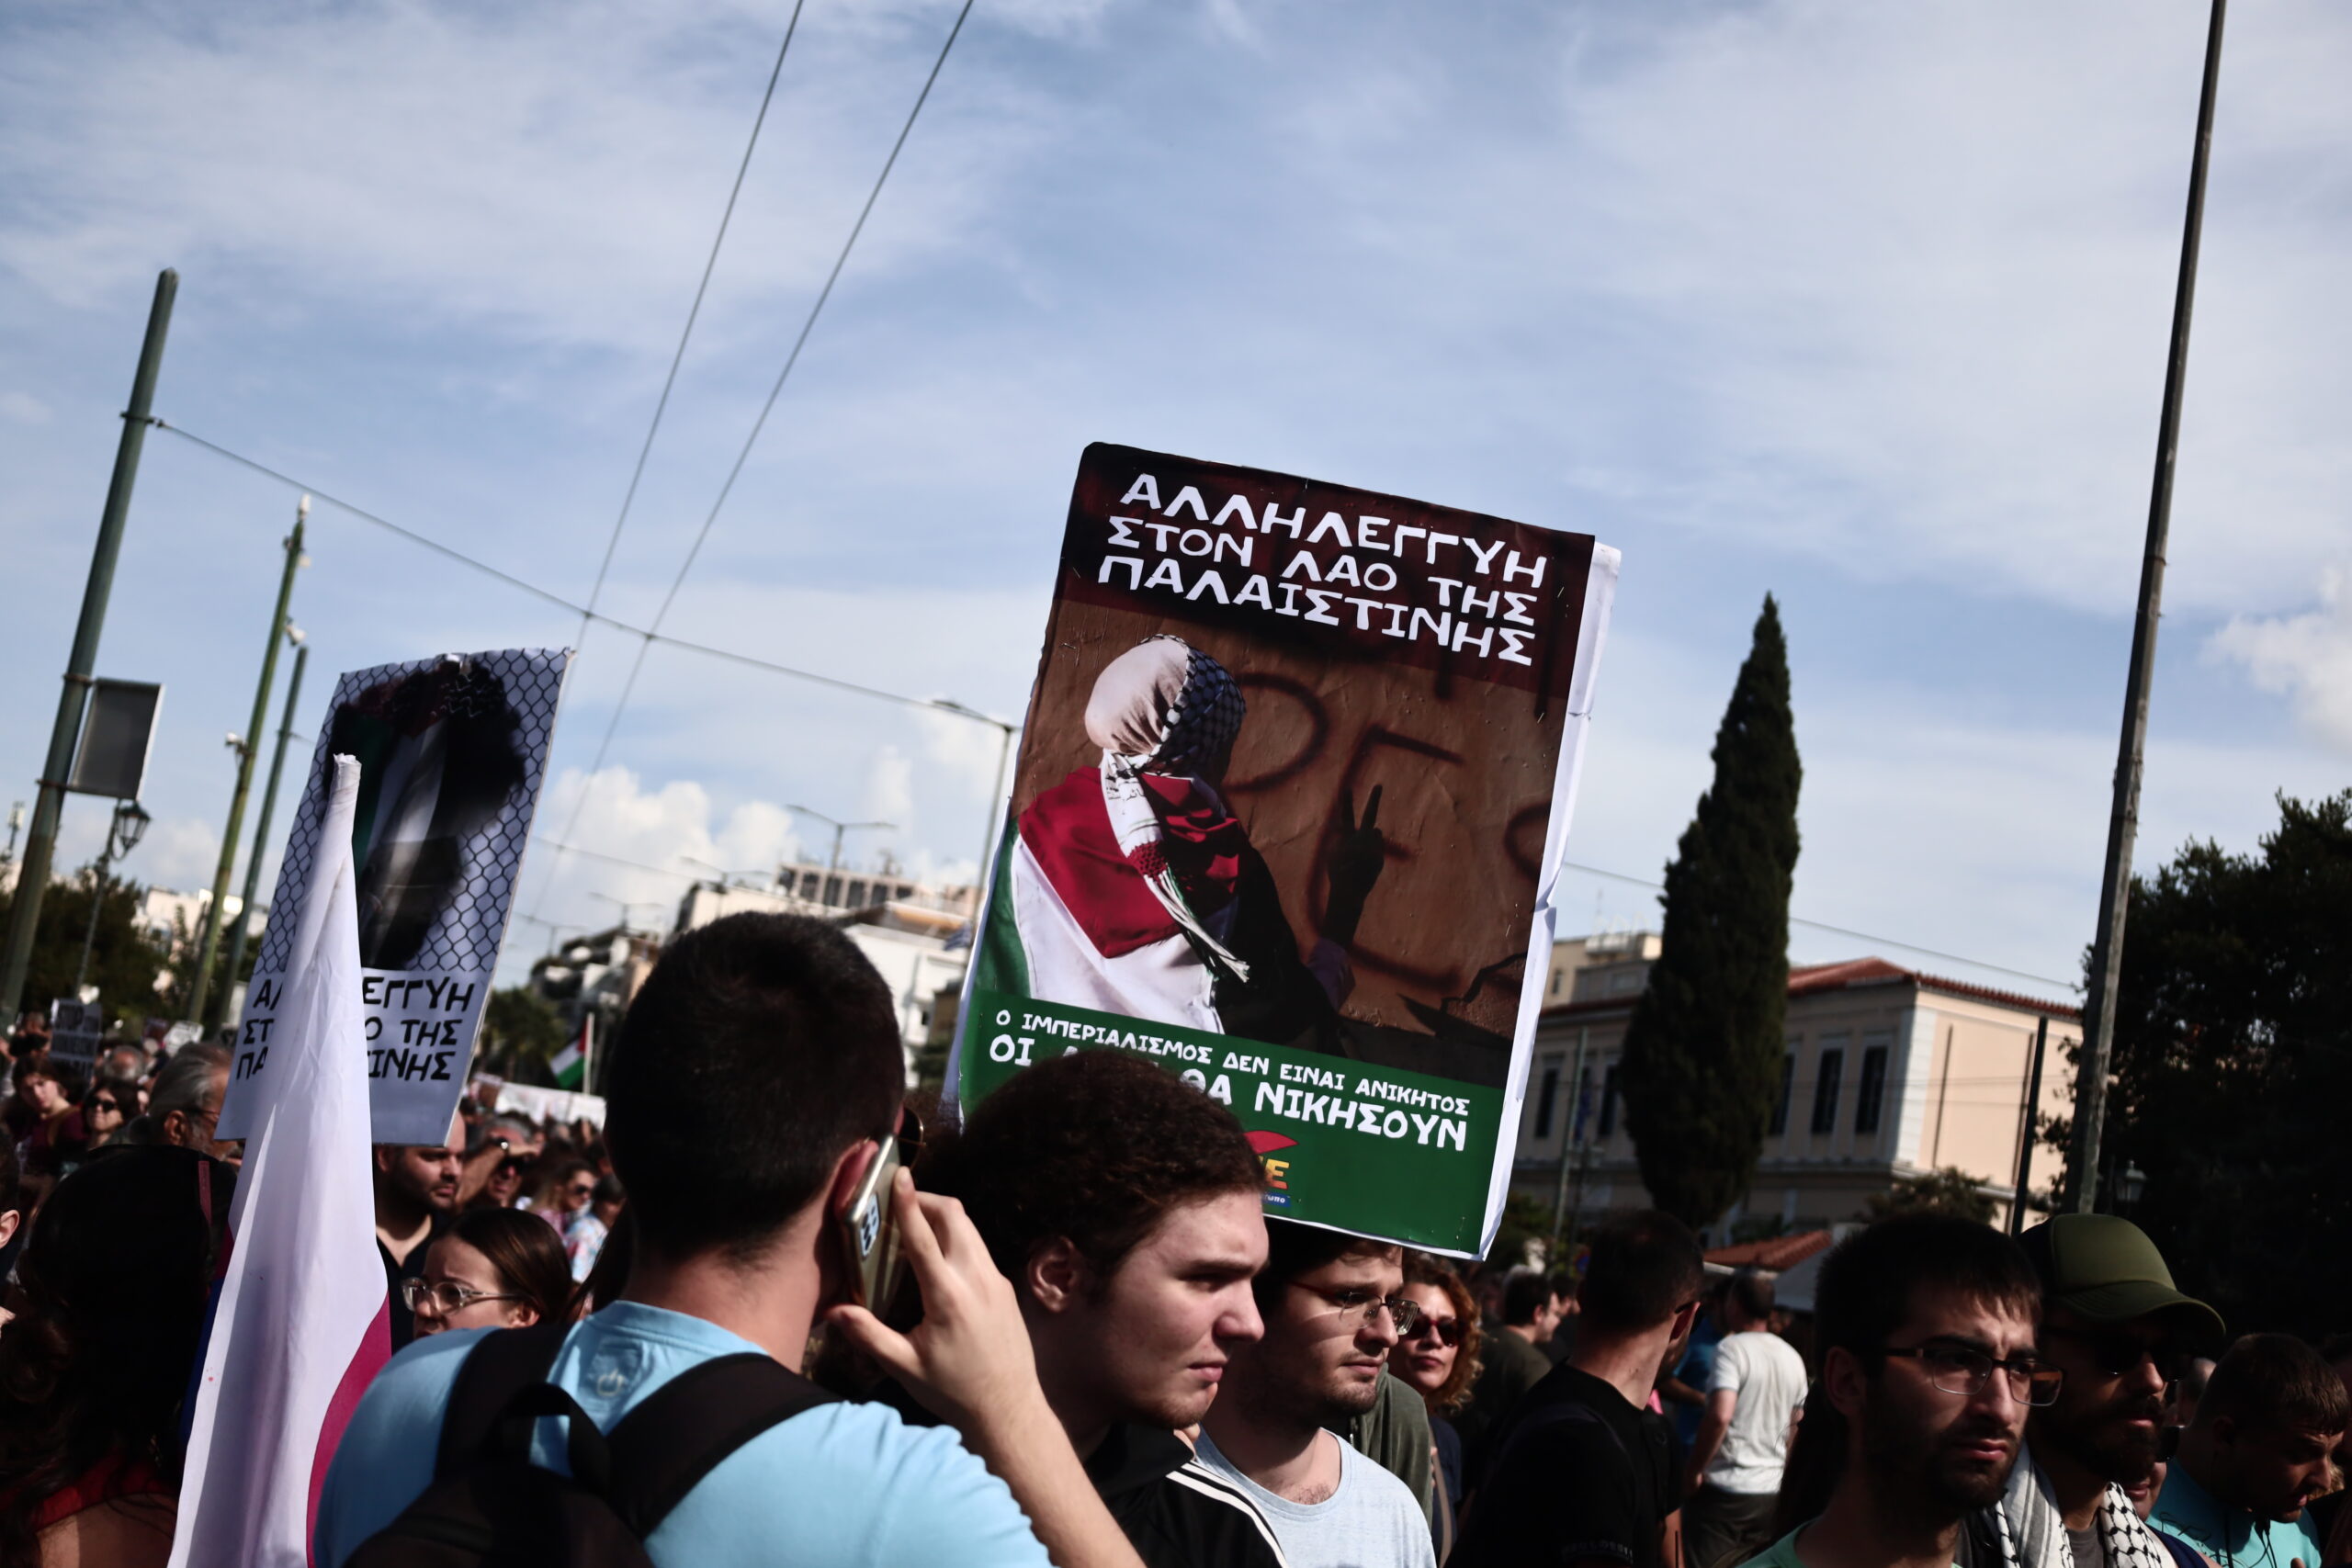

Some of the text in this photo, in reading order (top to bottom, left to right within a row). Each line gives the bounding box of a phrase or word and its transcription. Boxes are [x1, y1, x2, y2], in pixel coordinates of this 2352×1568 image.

[1107, 515, 1538, 626] ΣΤΟΝ ΛΑΟ ΤΗΣ
[1119, 473, 1547, 589] ΑΛΛΗΛΕΓΓΥΗ
[1098, 555, 1536, 667] ΠΑΛΑΙΣΤΙΝΗΣ
[401, 1019, 463, 1046] ΤΗΣ
[996, 1009, 1471, 1116] Ο ΙΜΠΕΡΙΑΛΙΣΜΟΣ ΔΕΝ ΕΙΝΑΙ ΑΝΙΚΗΤΟΣ
[989, 1033, 1035, 1066] ΟΙ
[1254, 1081, 1467, 1152] ΝΙΚΗΣΟΥΝ
